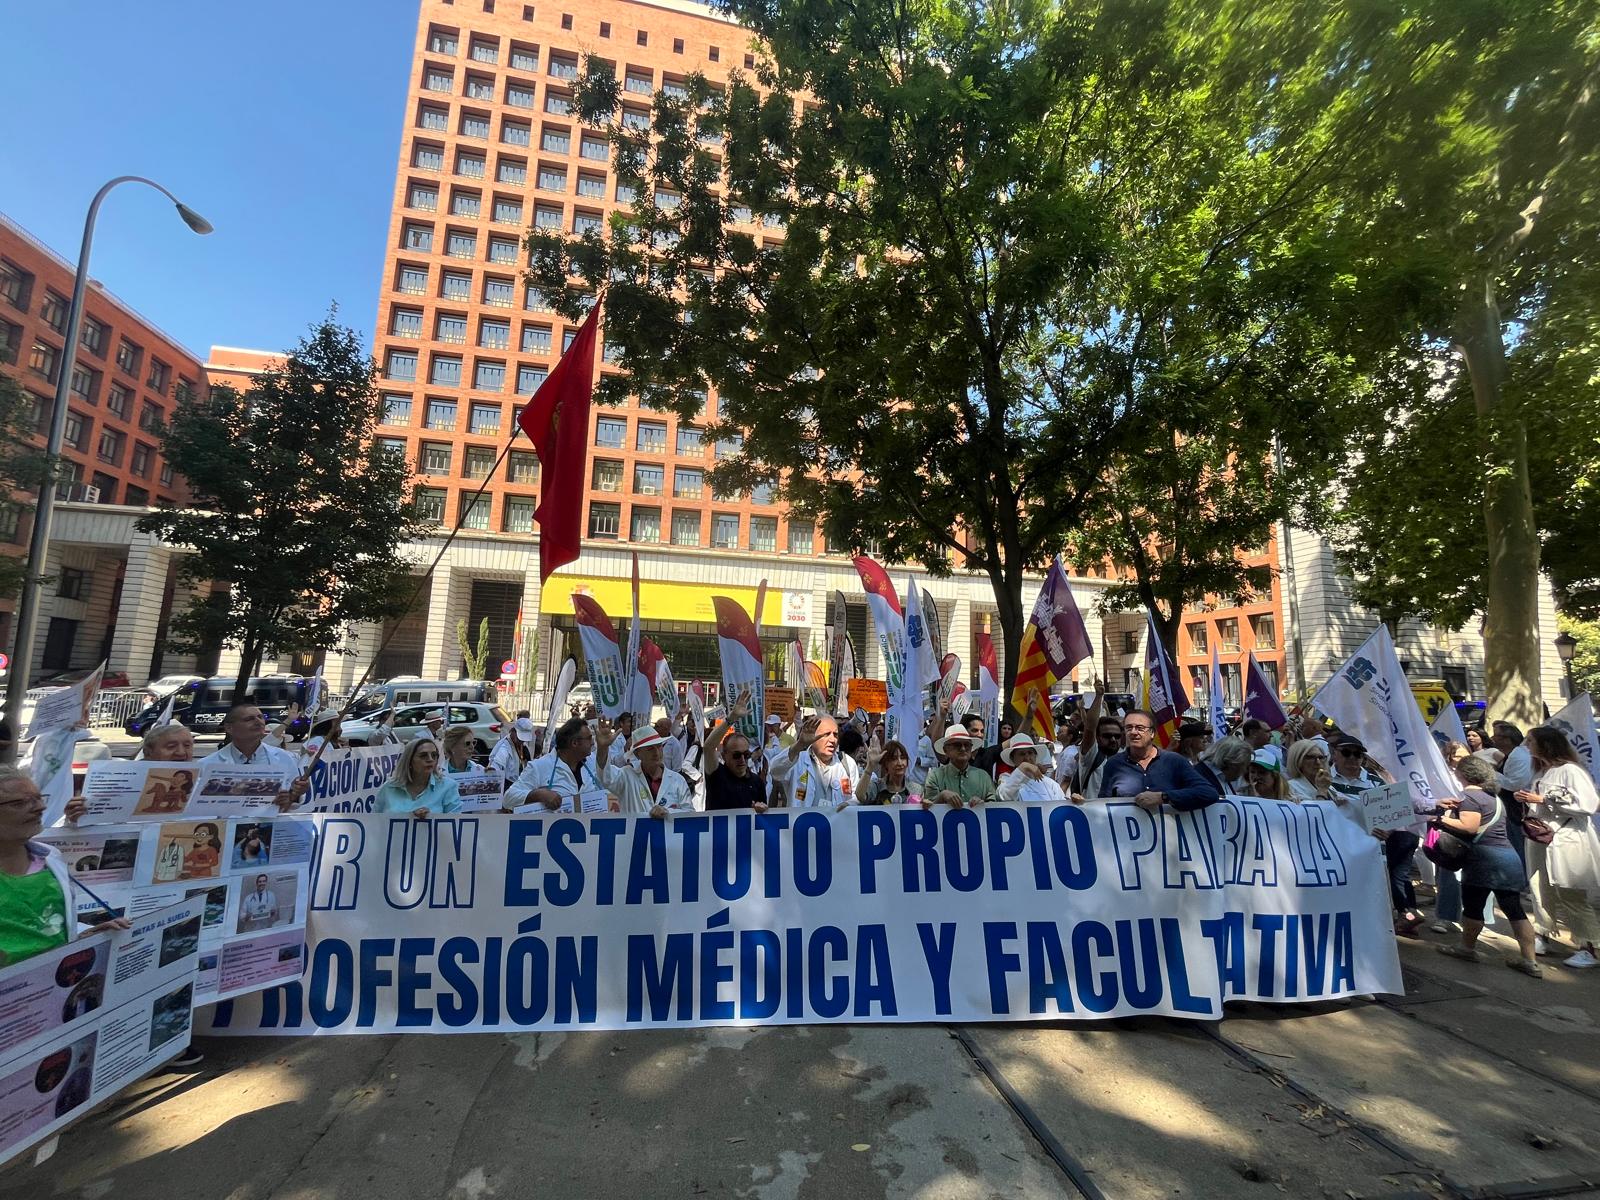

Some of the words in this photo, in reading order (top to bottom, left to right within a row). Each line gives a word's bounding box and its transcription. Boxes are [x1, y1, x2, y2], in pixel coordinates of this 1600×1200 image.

[587, 659, 597, 683] Médico
[857, 680, 880, 688] SOS
[592, 684, 603, 714] Sindicato
[887, 714, 895, 739] Médico
[363, 753, 402, 790] ESPE
[1409, 770, 1434, 801] CES
[384, 818, 480, 910] UN
[504, 810, 833, 907] ESTATUTO
[859, 804, 1098, 895] PROPIO
[1108, 799, 1278, 890] PARA
[1285, 802, 1347, 886] LA
[167, 910, 190, 923] SUELO
[625, 907, 898, 1023] MÉDICA
[916, 922, 957, 1016] Y
